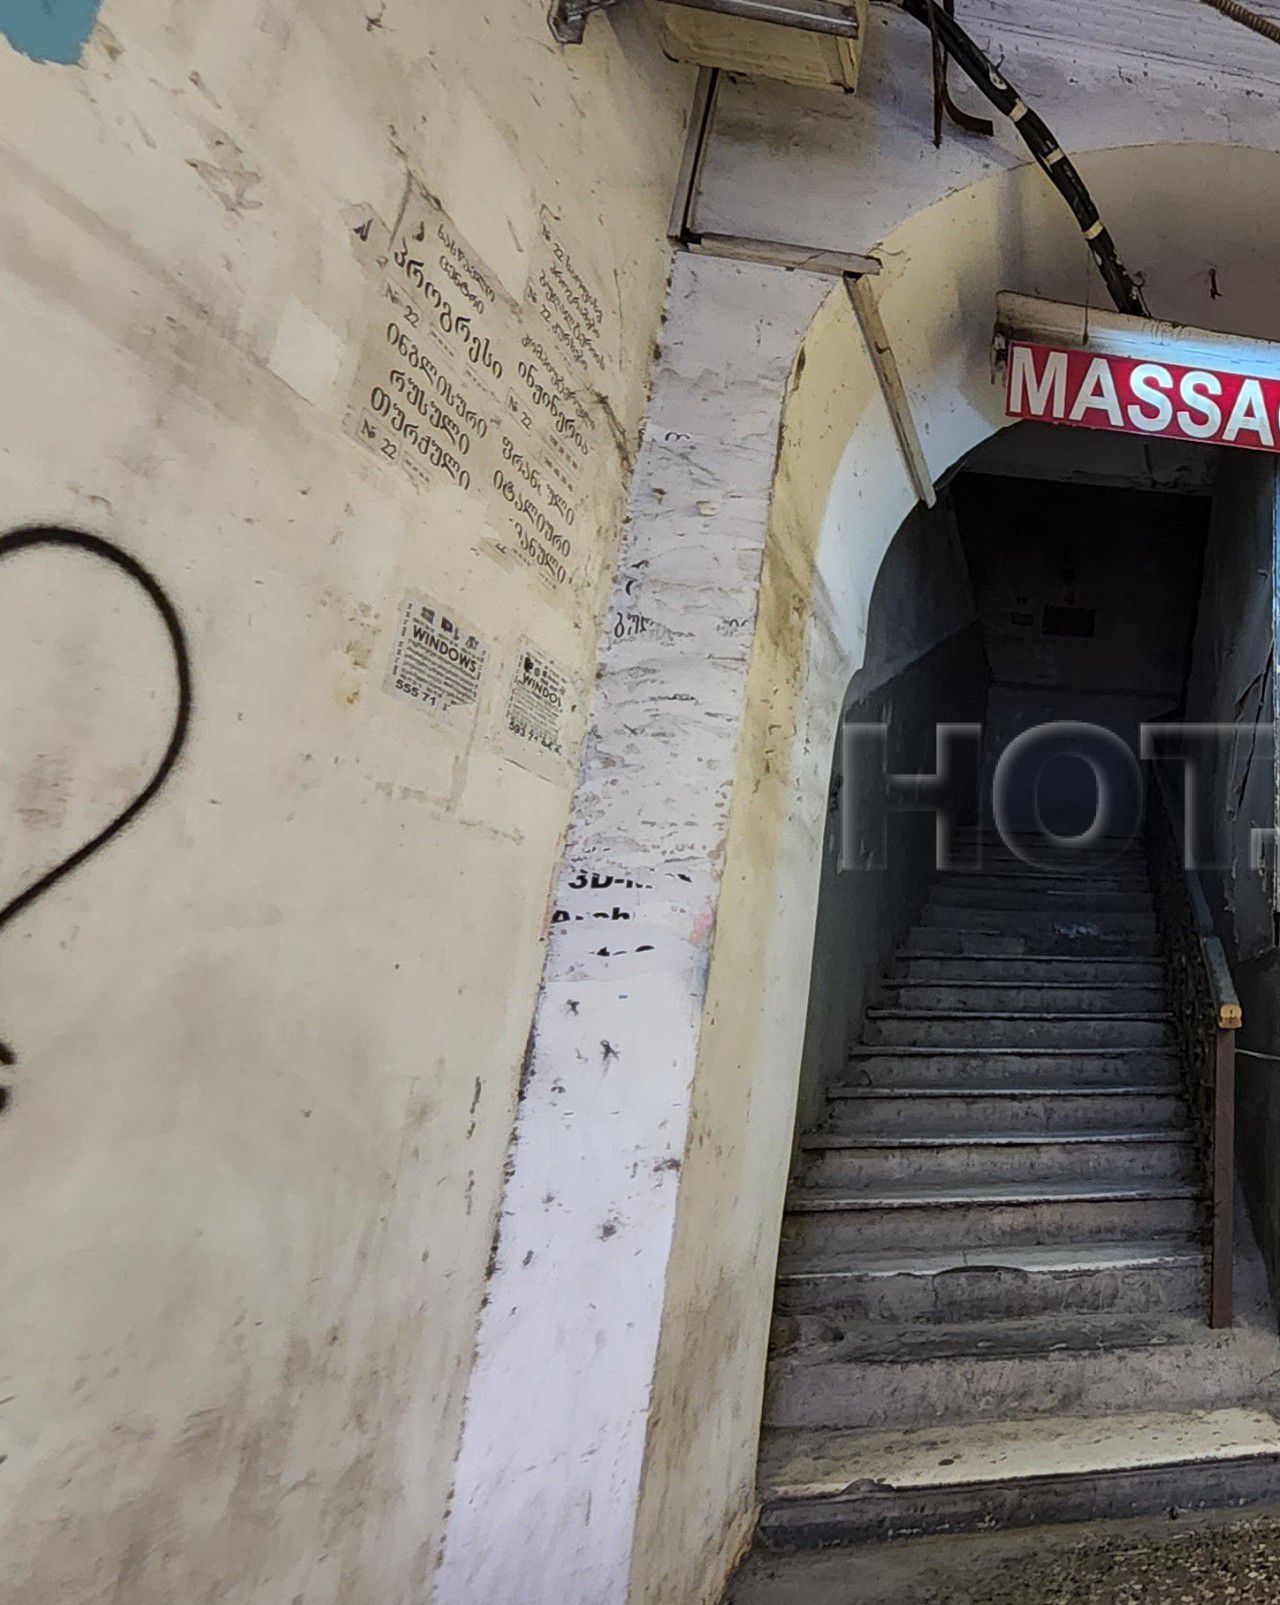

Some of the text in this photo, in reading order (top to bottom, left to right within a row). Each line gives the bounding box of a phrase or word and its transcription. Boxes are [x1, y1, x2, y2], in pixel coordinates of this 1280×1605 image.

[438, 223, 495, 302] სასწავლო
[440, 255, 484, 314] ცენტრი
[394, 236, 503, 379] პროგრესი
[403, 305, 420, 329] 22
[386, 322, 488, 438] ინგლისური
[390, 369, 470, 455] რუსული
[517, 361, 589, 456] ინჟინერია
[370, 386, 470, 490] თურქული
[380, 438, 397, 460] 22
[520, 411, 532, 430] 22
[493, 470, 570, 557] იტალიური
[395, 678, 420, 698] 555
[413, 624, 477, 673] WINDOWS
